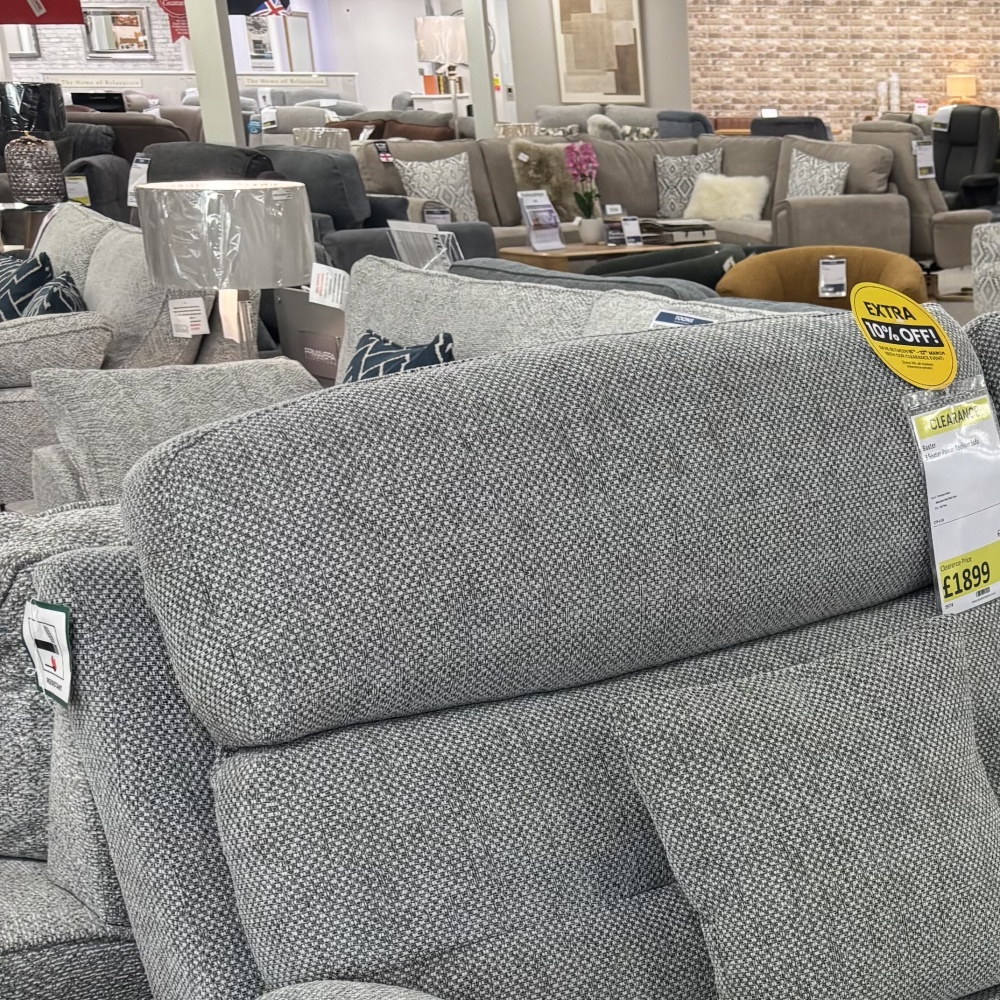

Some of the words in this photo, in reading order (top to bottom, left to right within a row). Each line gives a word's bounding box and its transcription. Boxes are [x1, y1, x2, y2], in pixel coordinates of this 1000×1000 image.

[863, 301, 917, 321] EXTRA
[865, 321, 900, 342] 10%
[899, 327, 940, 344] OFF!
[929, 405, 982, 431] CLEARANCE
[922, 442, 937, 452] Baxter
[928, 450, 942, 460] Seater
[970, 438, 980, 447] Sofa
[940, 560, 961, 572] Clearance
[961, 556, 972, 566] Price
[943, 561, 990, 599] £1899
